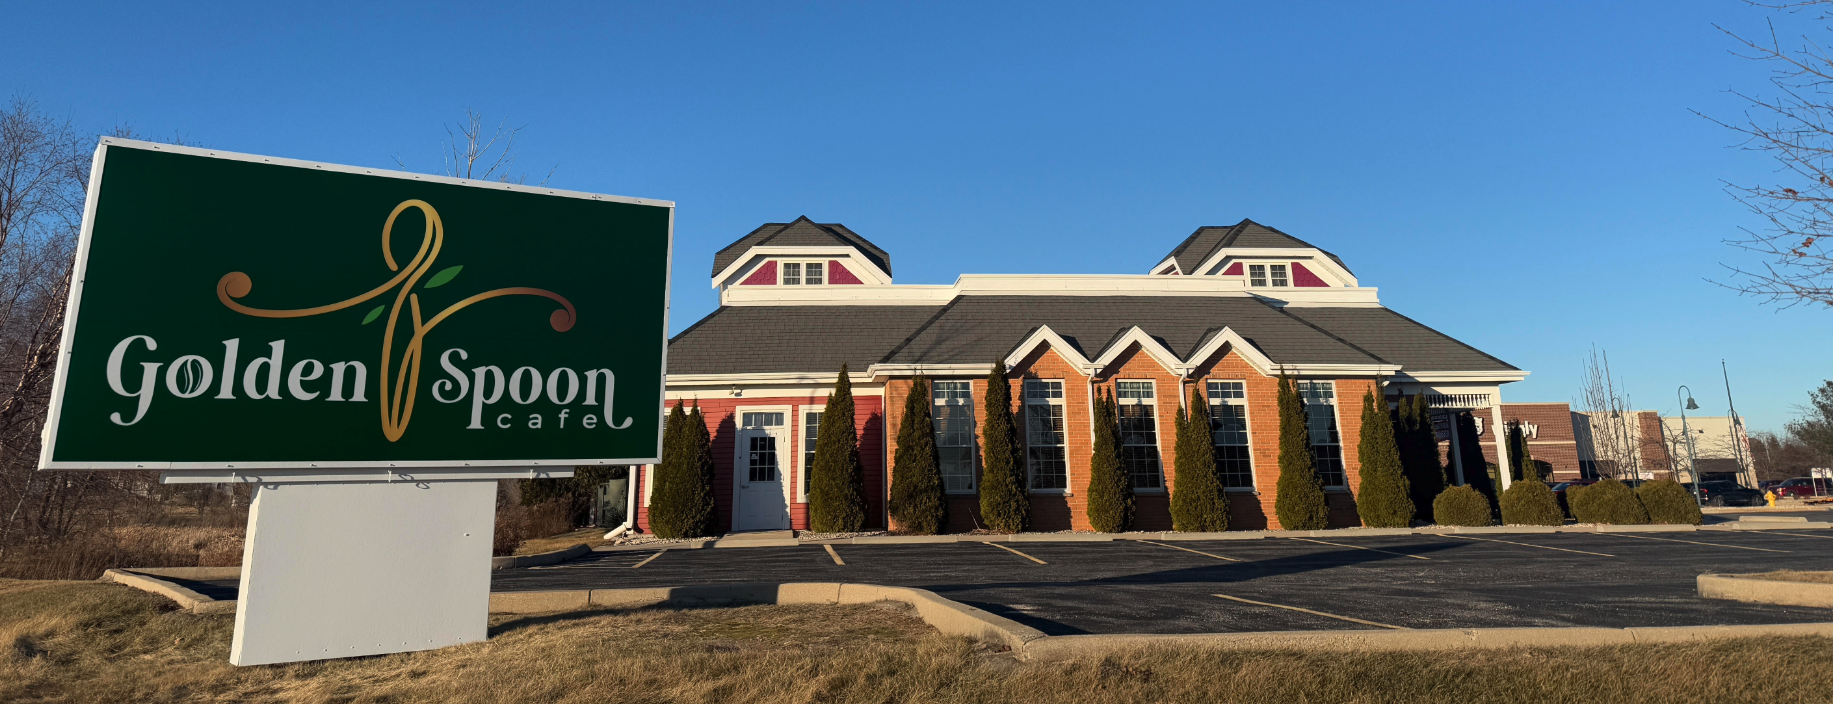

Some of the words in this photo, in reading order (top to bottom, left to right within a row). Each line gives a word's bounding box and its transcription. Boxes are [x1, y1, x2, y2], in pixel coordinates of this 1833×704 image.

[106, 334, 369, 427] Golden
[432, 348, 634, 430] Spoon
[497, 408, 598, 429] cafe
